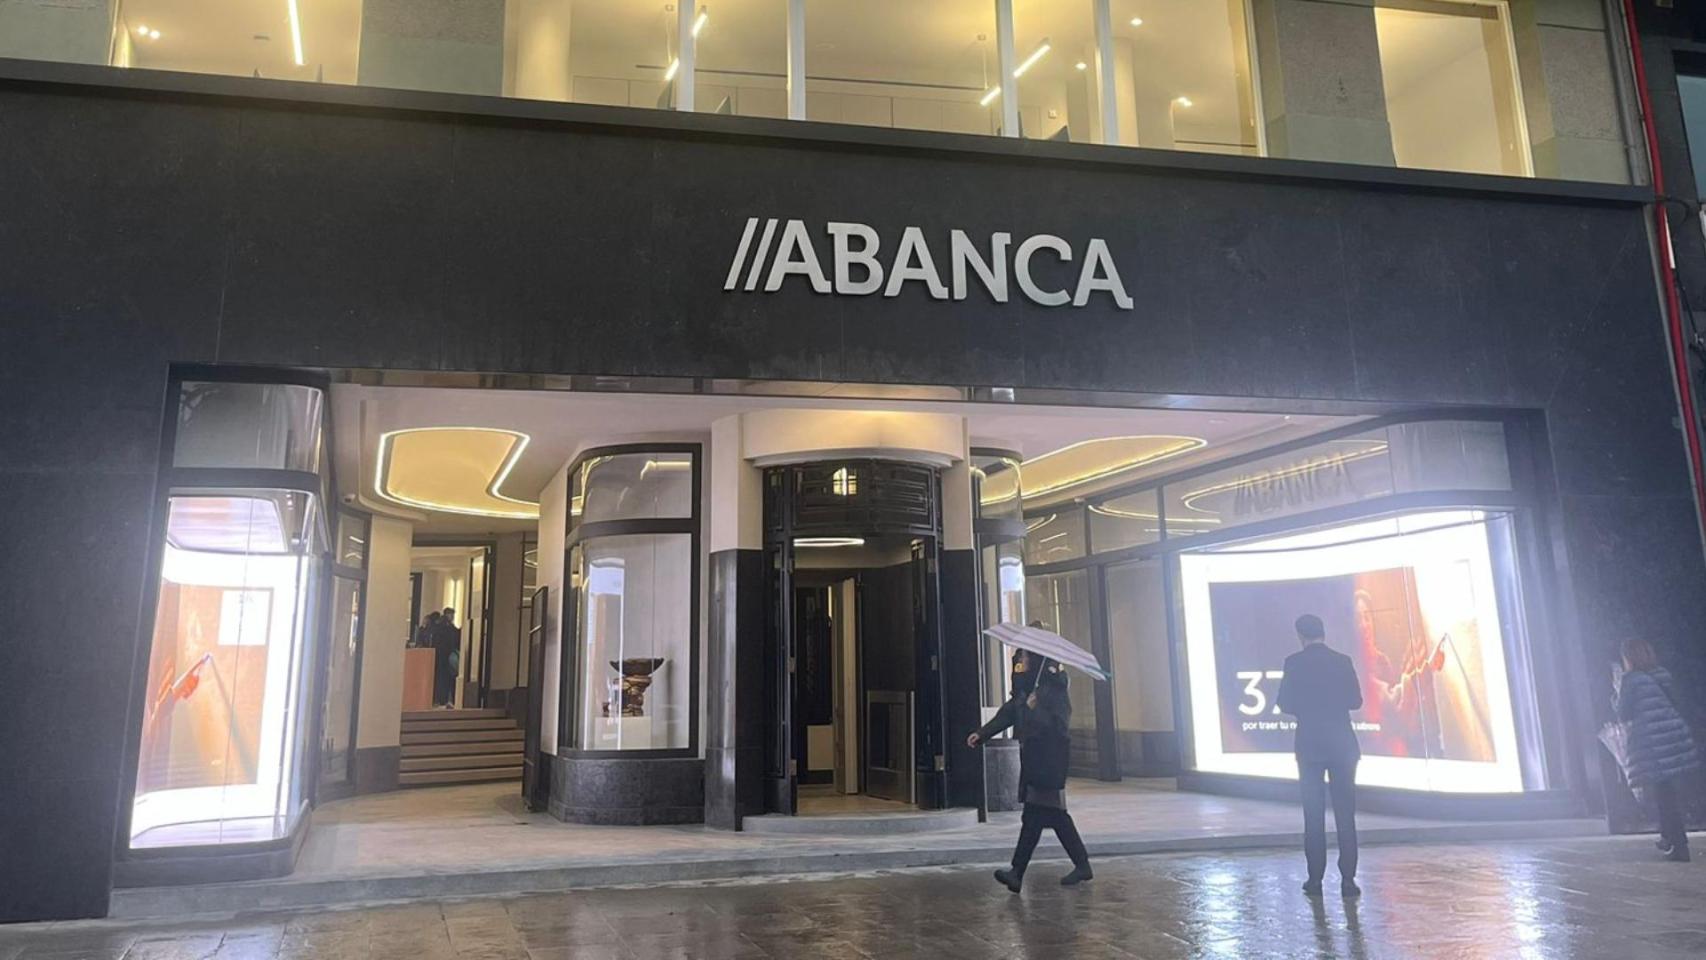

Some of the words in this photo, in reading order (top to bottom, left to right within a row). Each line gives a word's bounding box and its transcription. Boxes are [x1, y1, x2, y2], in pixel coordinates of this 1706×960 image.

[1242, 722, 1257, 731] por
[1259, 721, 1278, 730] traer
[1280, 721, 1289, 730] tu
